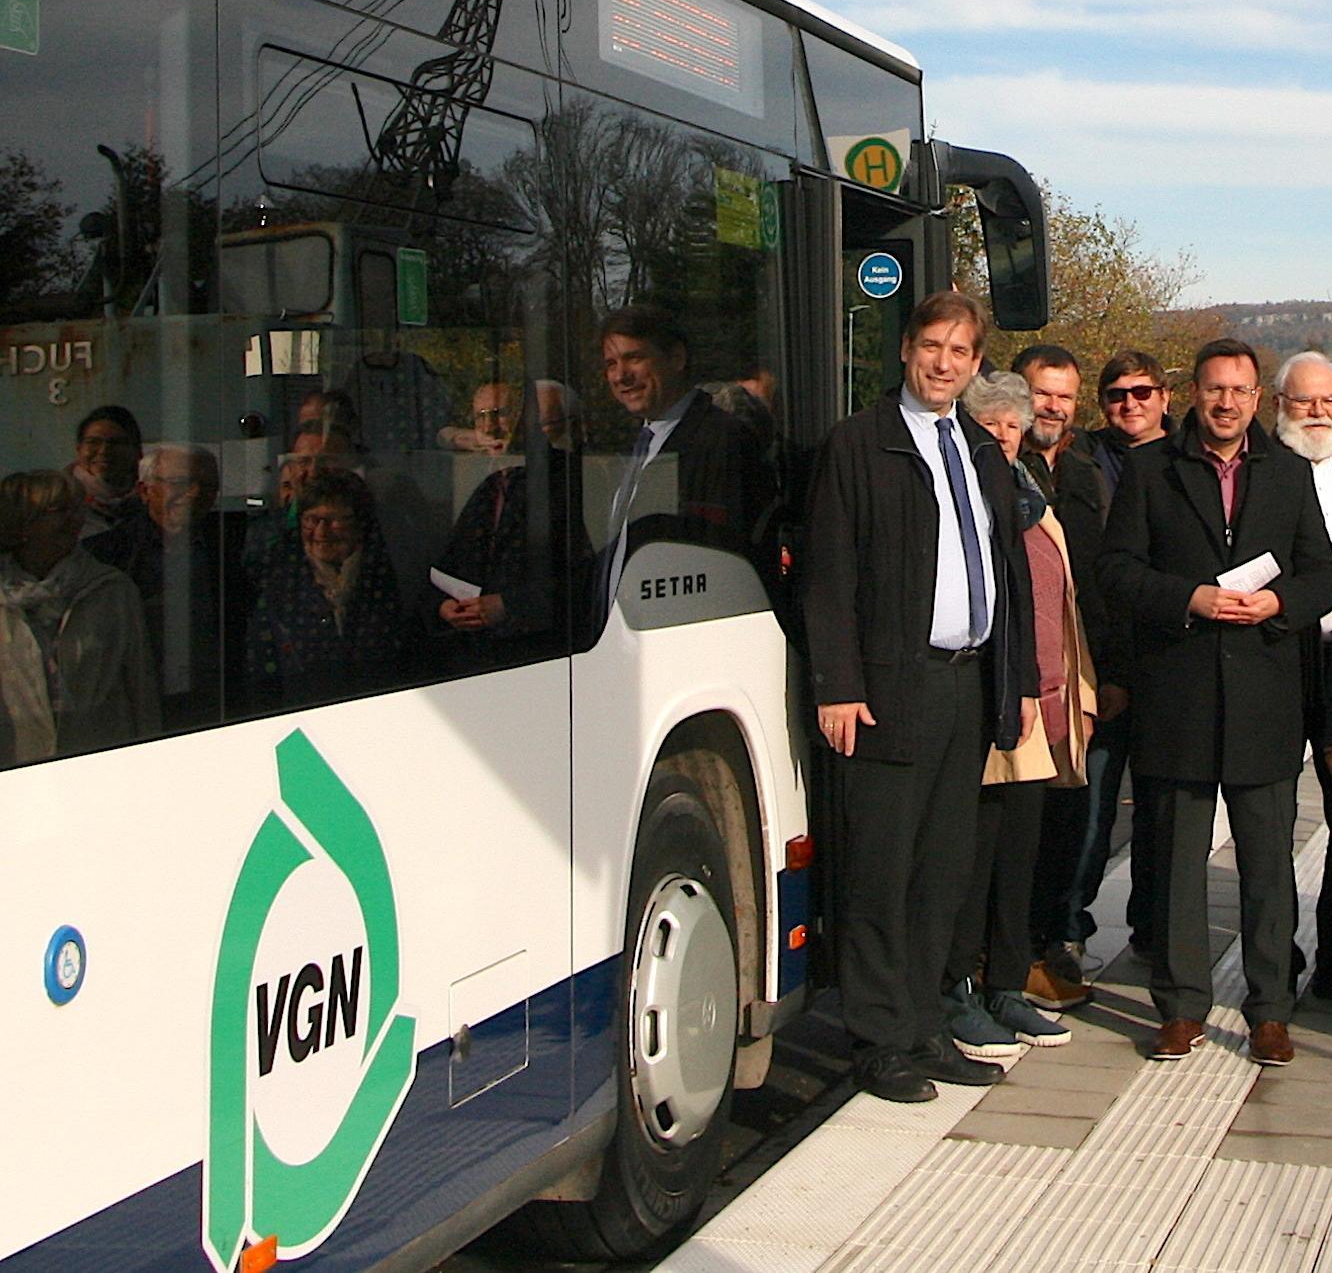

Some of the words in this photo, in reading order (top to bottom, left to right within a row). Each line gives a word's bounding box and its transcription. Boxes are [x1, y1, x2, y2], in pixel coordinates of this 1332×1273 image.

[871, 266, 889, 274] Kein
[864, 276, 897, 284] Ausgang
[640, 573, 707, 600] SETRA
[256, 945, 363, 1078] VGN
